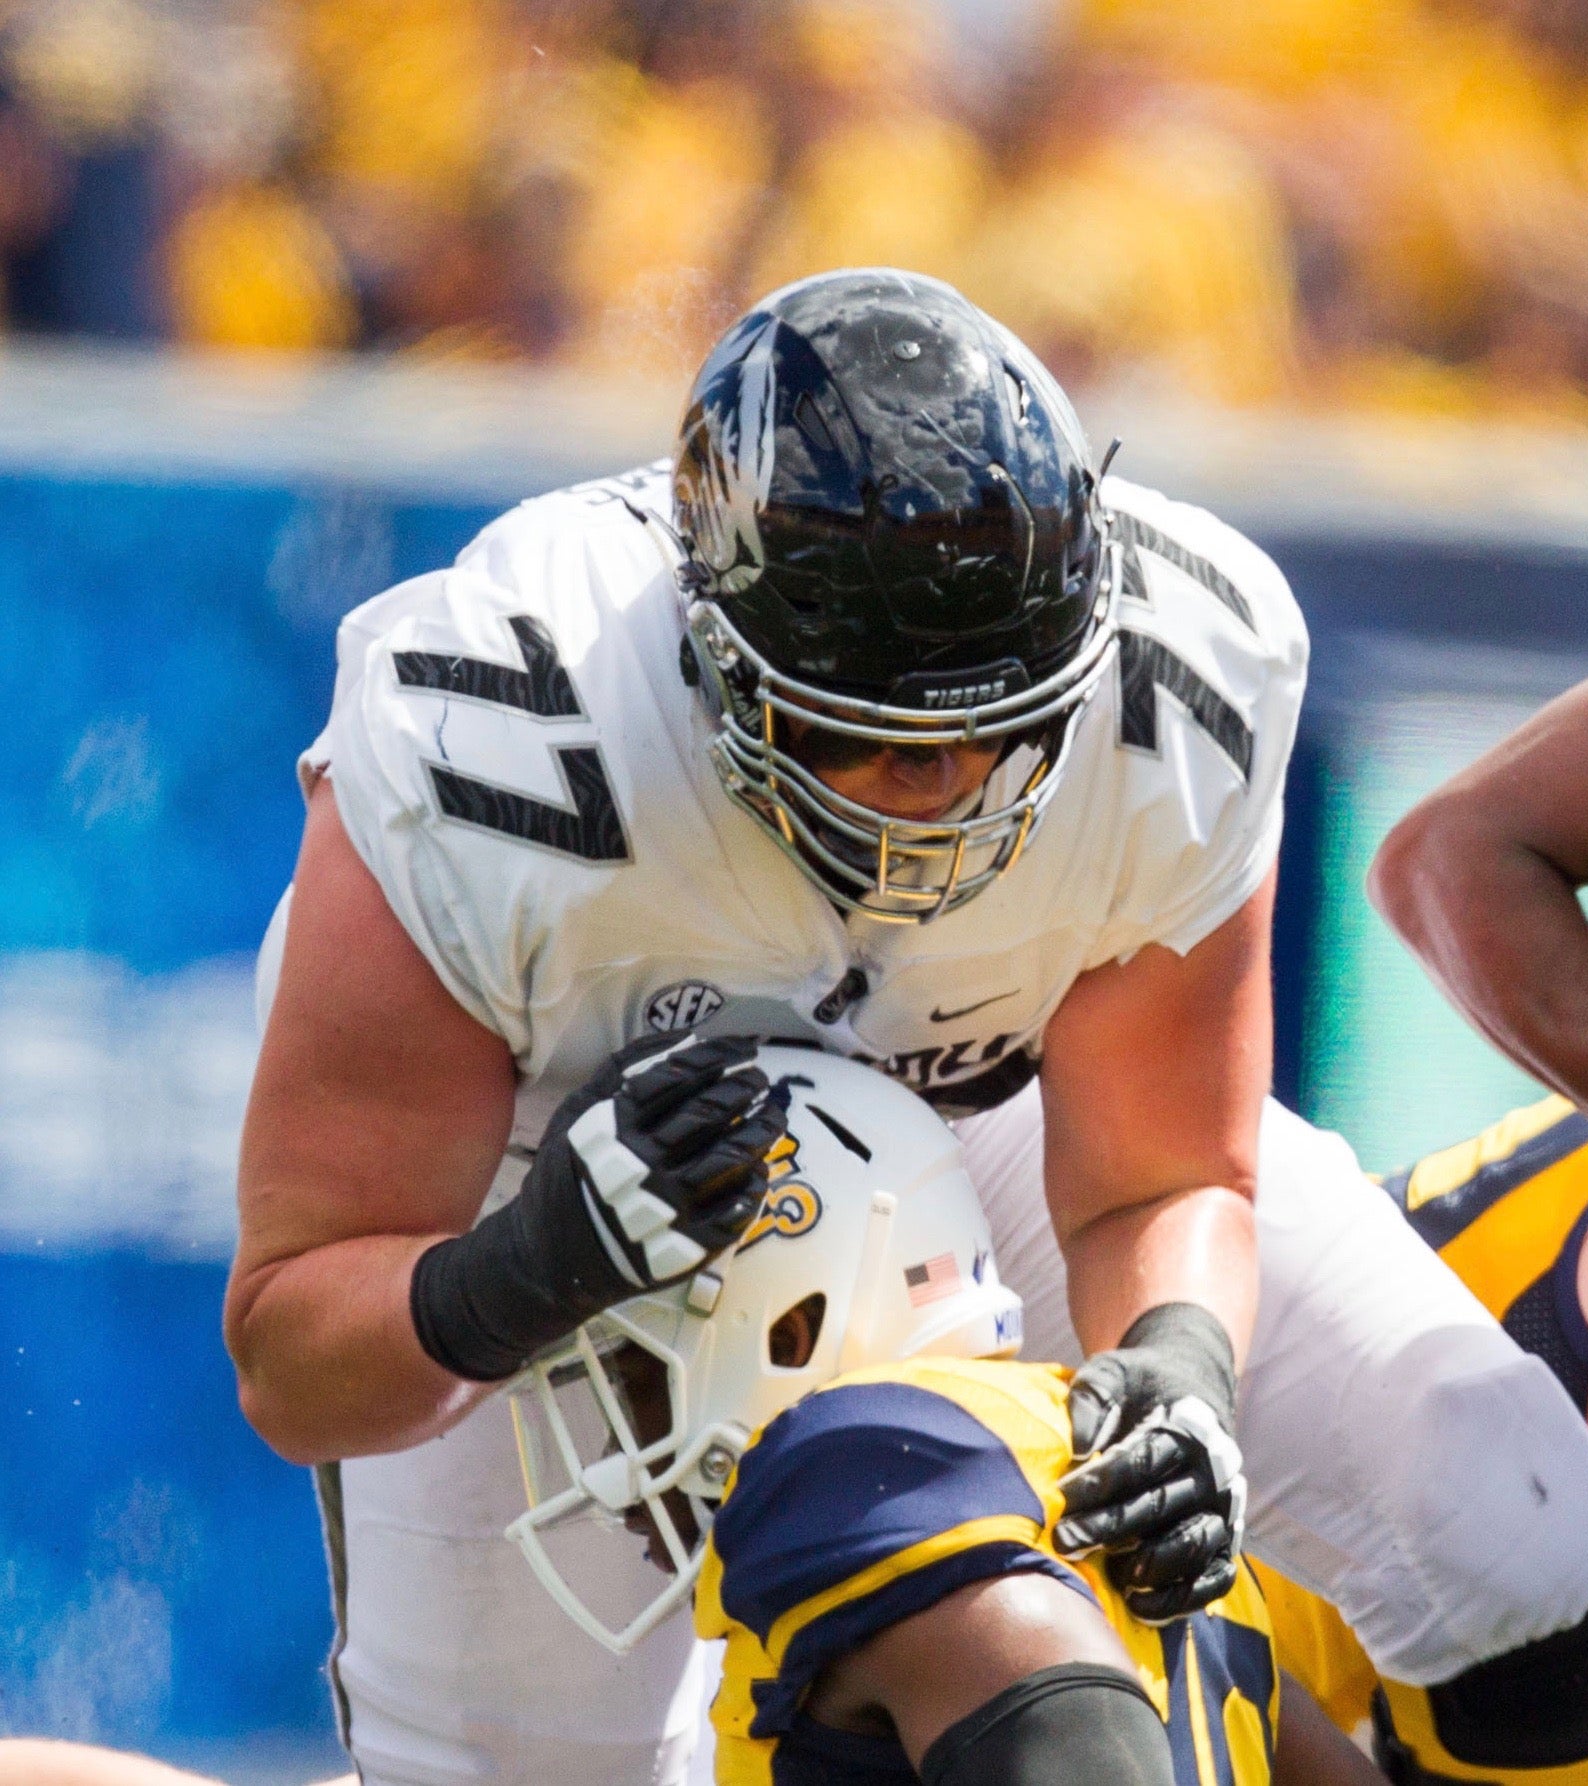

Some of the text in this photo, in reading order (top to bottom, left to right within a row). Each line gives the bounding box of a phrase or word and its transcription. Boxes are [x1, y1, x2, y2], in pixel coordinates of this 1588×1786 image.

[924, 679, 1005, 708] TIGERS
[1106, 508, 1258, 790] 77
[388, 613, 634, 867] 77
[649, 982, 724, 1033] SEC
